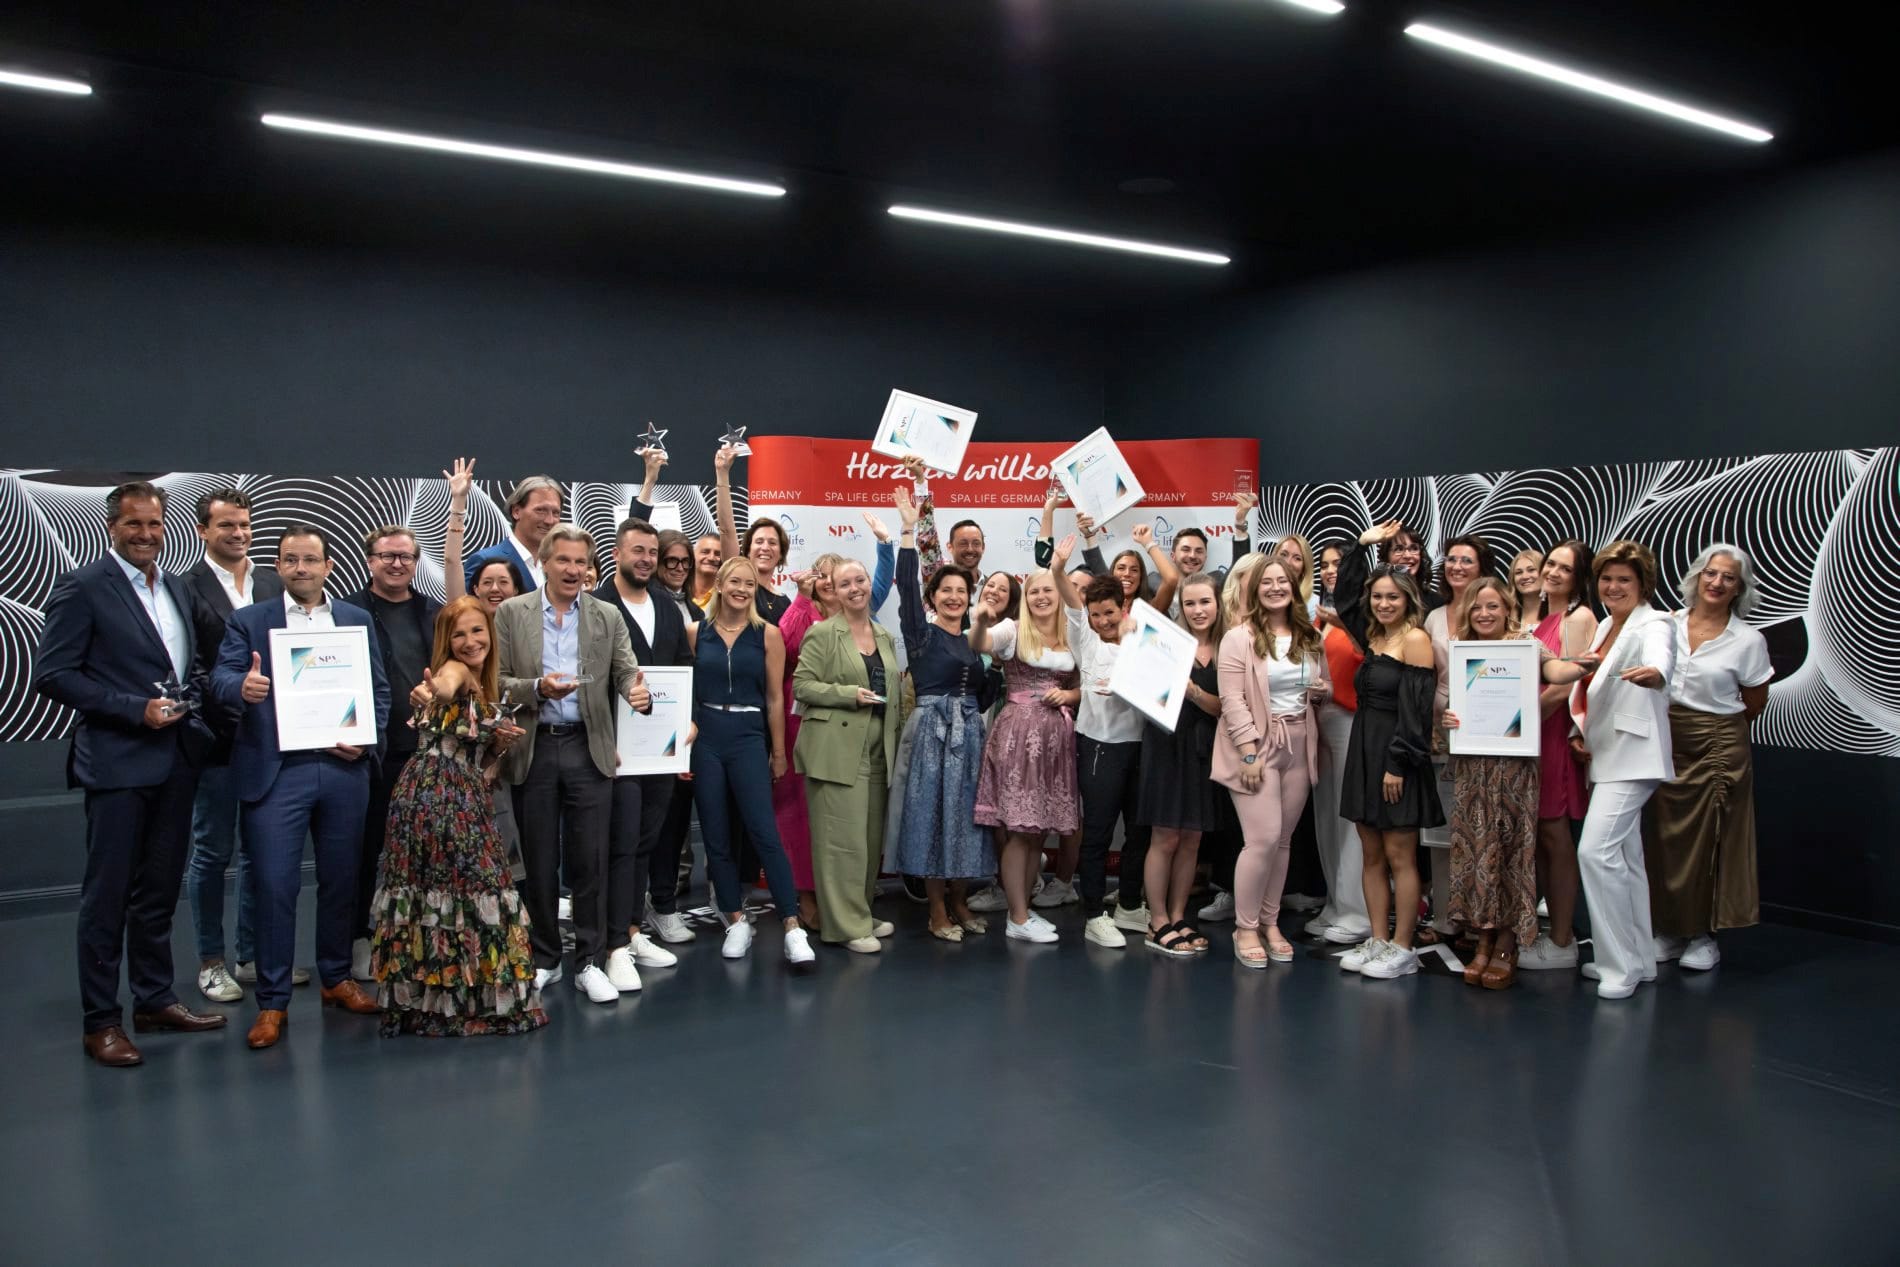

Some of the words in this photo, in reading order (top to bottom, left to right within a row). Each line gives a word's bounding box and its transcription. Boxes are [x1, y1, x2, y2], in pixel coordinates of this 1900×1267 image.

[964, 453, 1056, 482] willko
[750, 490, 802, 500] GERMANY
[824, 491, 844, 502] SPA
[847, 492, 868, 502] LIFE
[950, 493, 972, 503] SPA
[975, 494, 997, 503] LIFE
[1001, 494, 1049, 504] GERMAN
[1211, 492, 1232, 502] SPA
